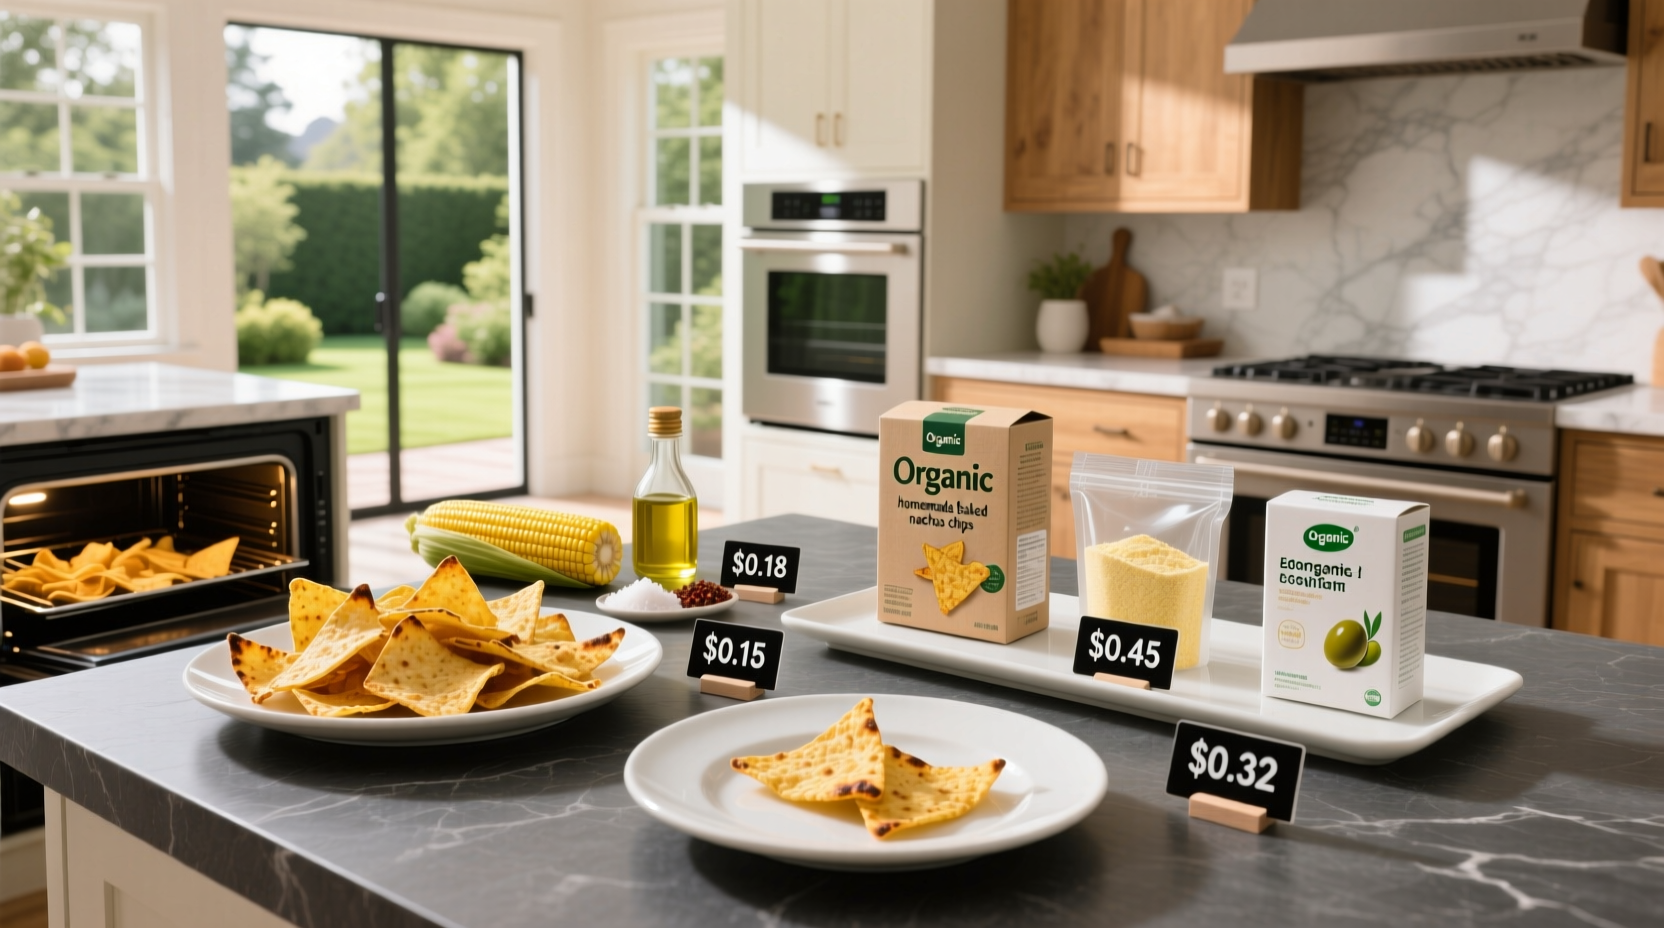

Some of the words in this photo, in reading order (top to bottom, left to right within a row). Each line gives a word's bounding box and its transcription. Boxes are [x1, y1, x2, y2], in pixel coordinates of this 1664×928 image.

[893, 456, 994, 495] Organic
[732, 548, 787, 578] $0.18
[703, 631, 766, 669] $0.15
[1088, 627, 1161, 669] $0.45
[1188, 737, 1278, 793] $0.32
